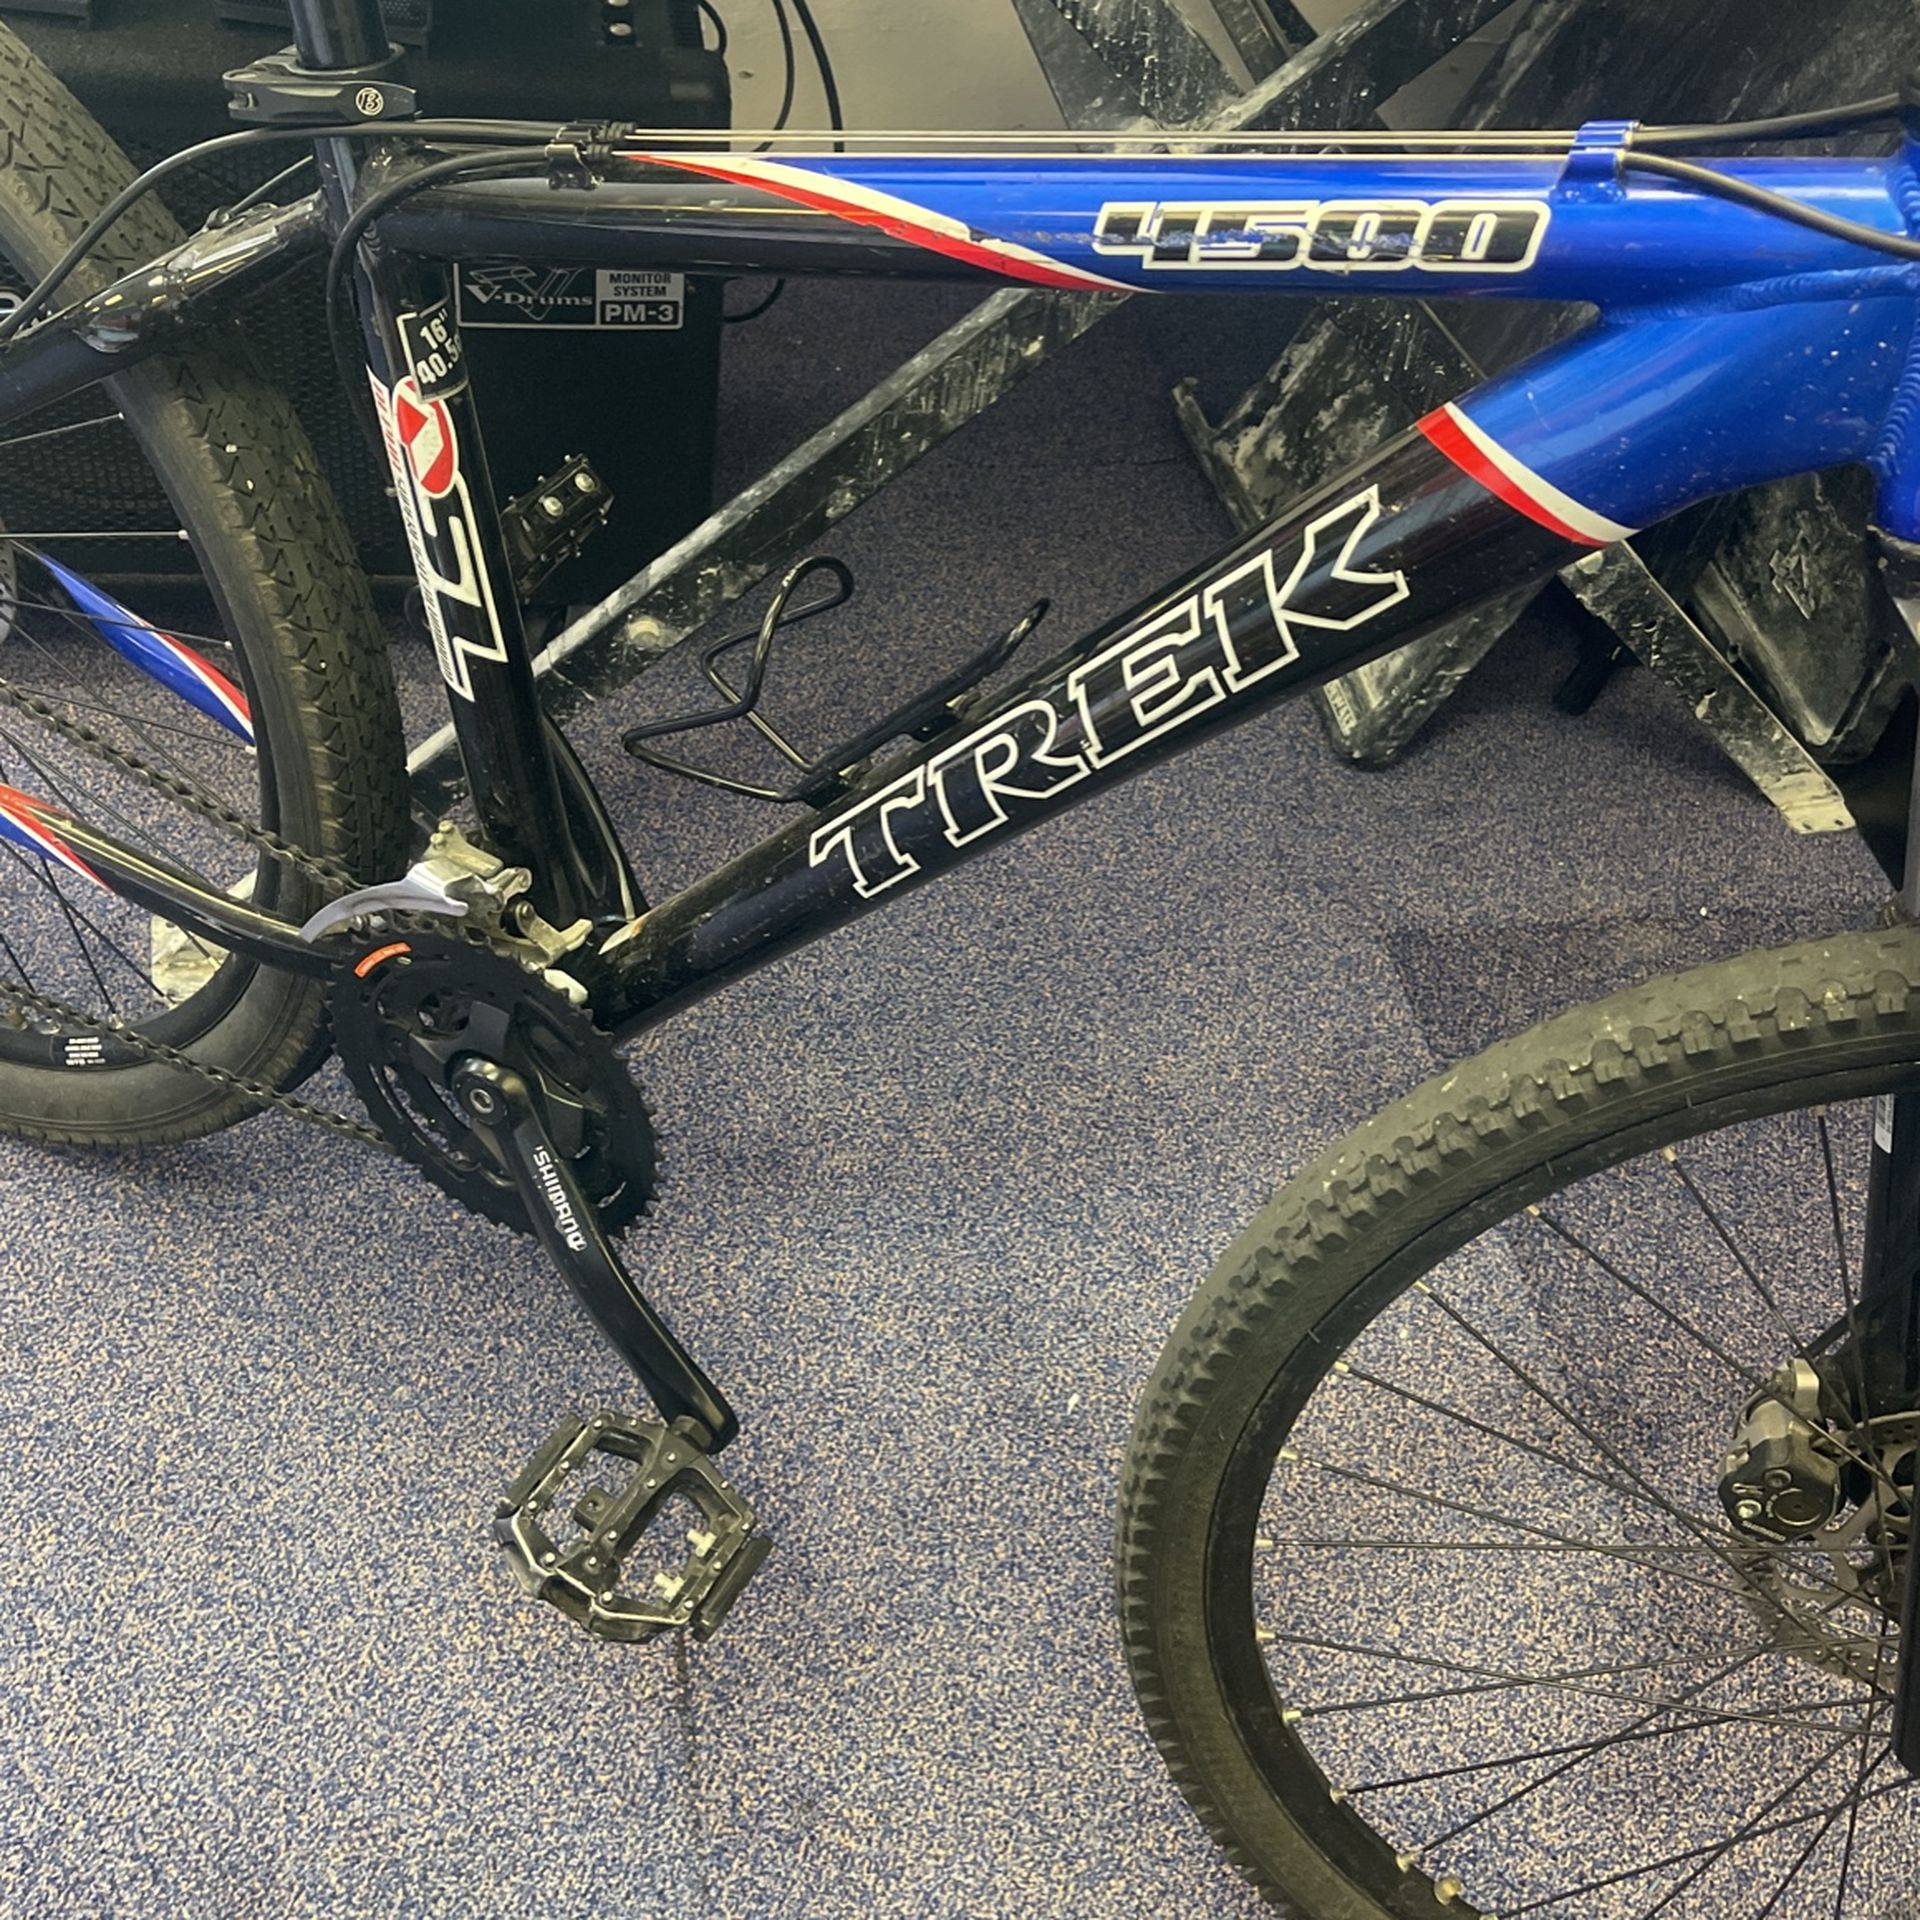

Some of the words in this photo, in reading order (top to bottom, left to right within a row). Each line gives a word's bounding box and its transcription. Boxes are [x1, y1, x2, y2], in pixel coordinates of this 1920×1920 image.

[1091, 199, 1551, 273] 4500
[609, 273, 672, 284] MONITOR
[465, 284, 592, 304] V-Drums
[613, 285, 667, 297] SYSTEM
[604, 304, 674, 322] PM-3
[809, 483, 1410, 899] TREK
